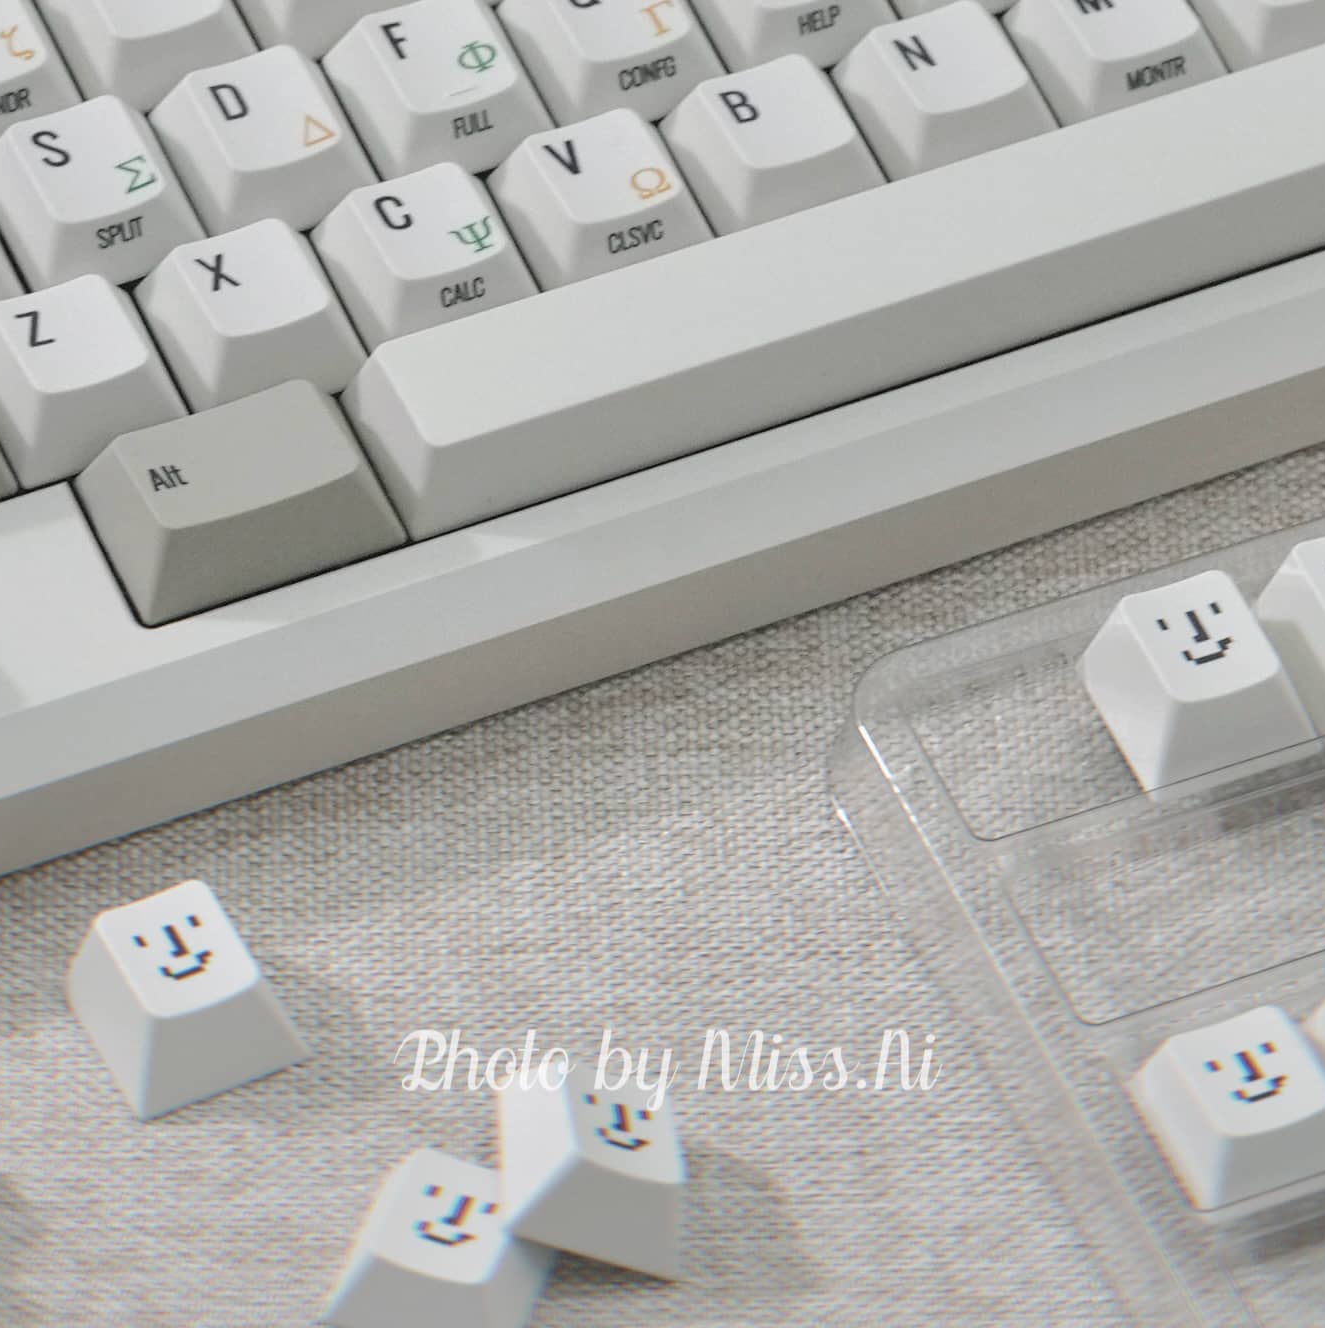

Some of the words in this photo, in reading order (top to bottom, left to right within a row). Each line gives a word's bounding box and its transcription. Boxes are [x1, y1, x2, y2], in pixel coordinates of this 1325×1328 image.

[798, 3, 842, 37] HELP
[379, 21, 411, 60] F
[892, 33, 936, 73] N
[208, 82, 250, 122] D
[718, 89, 760, 125] B
[452, 110, 495, 140] FULL
[31, 130, 72, 169] S
[542, 139, 583, 176] V
[372, 194, 414, 233] C
[96, 215, 145, 251] SPLIT
[194, 252, 243, 293] X
[440, 277, 487, 310] CALC
[13, 310, 56, 349] Z
[149, 463, 189, 493] Alt
